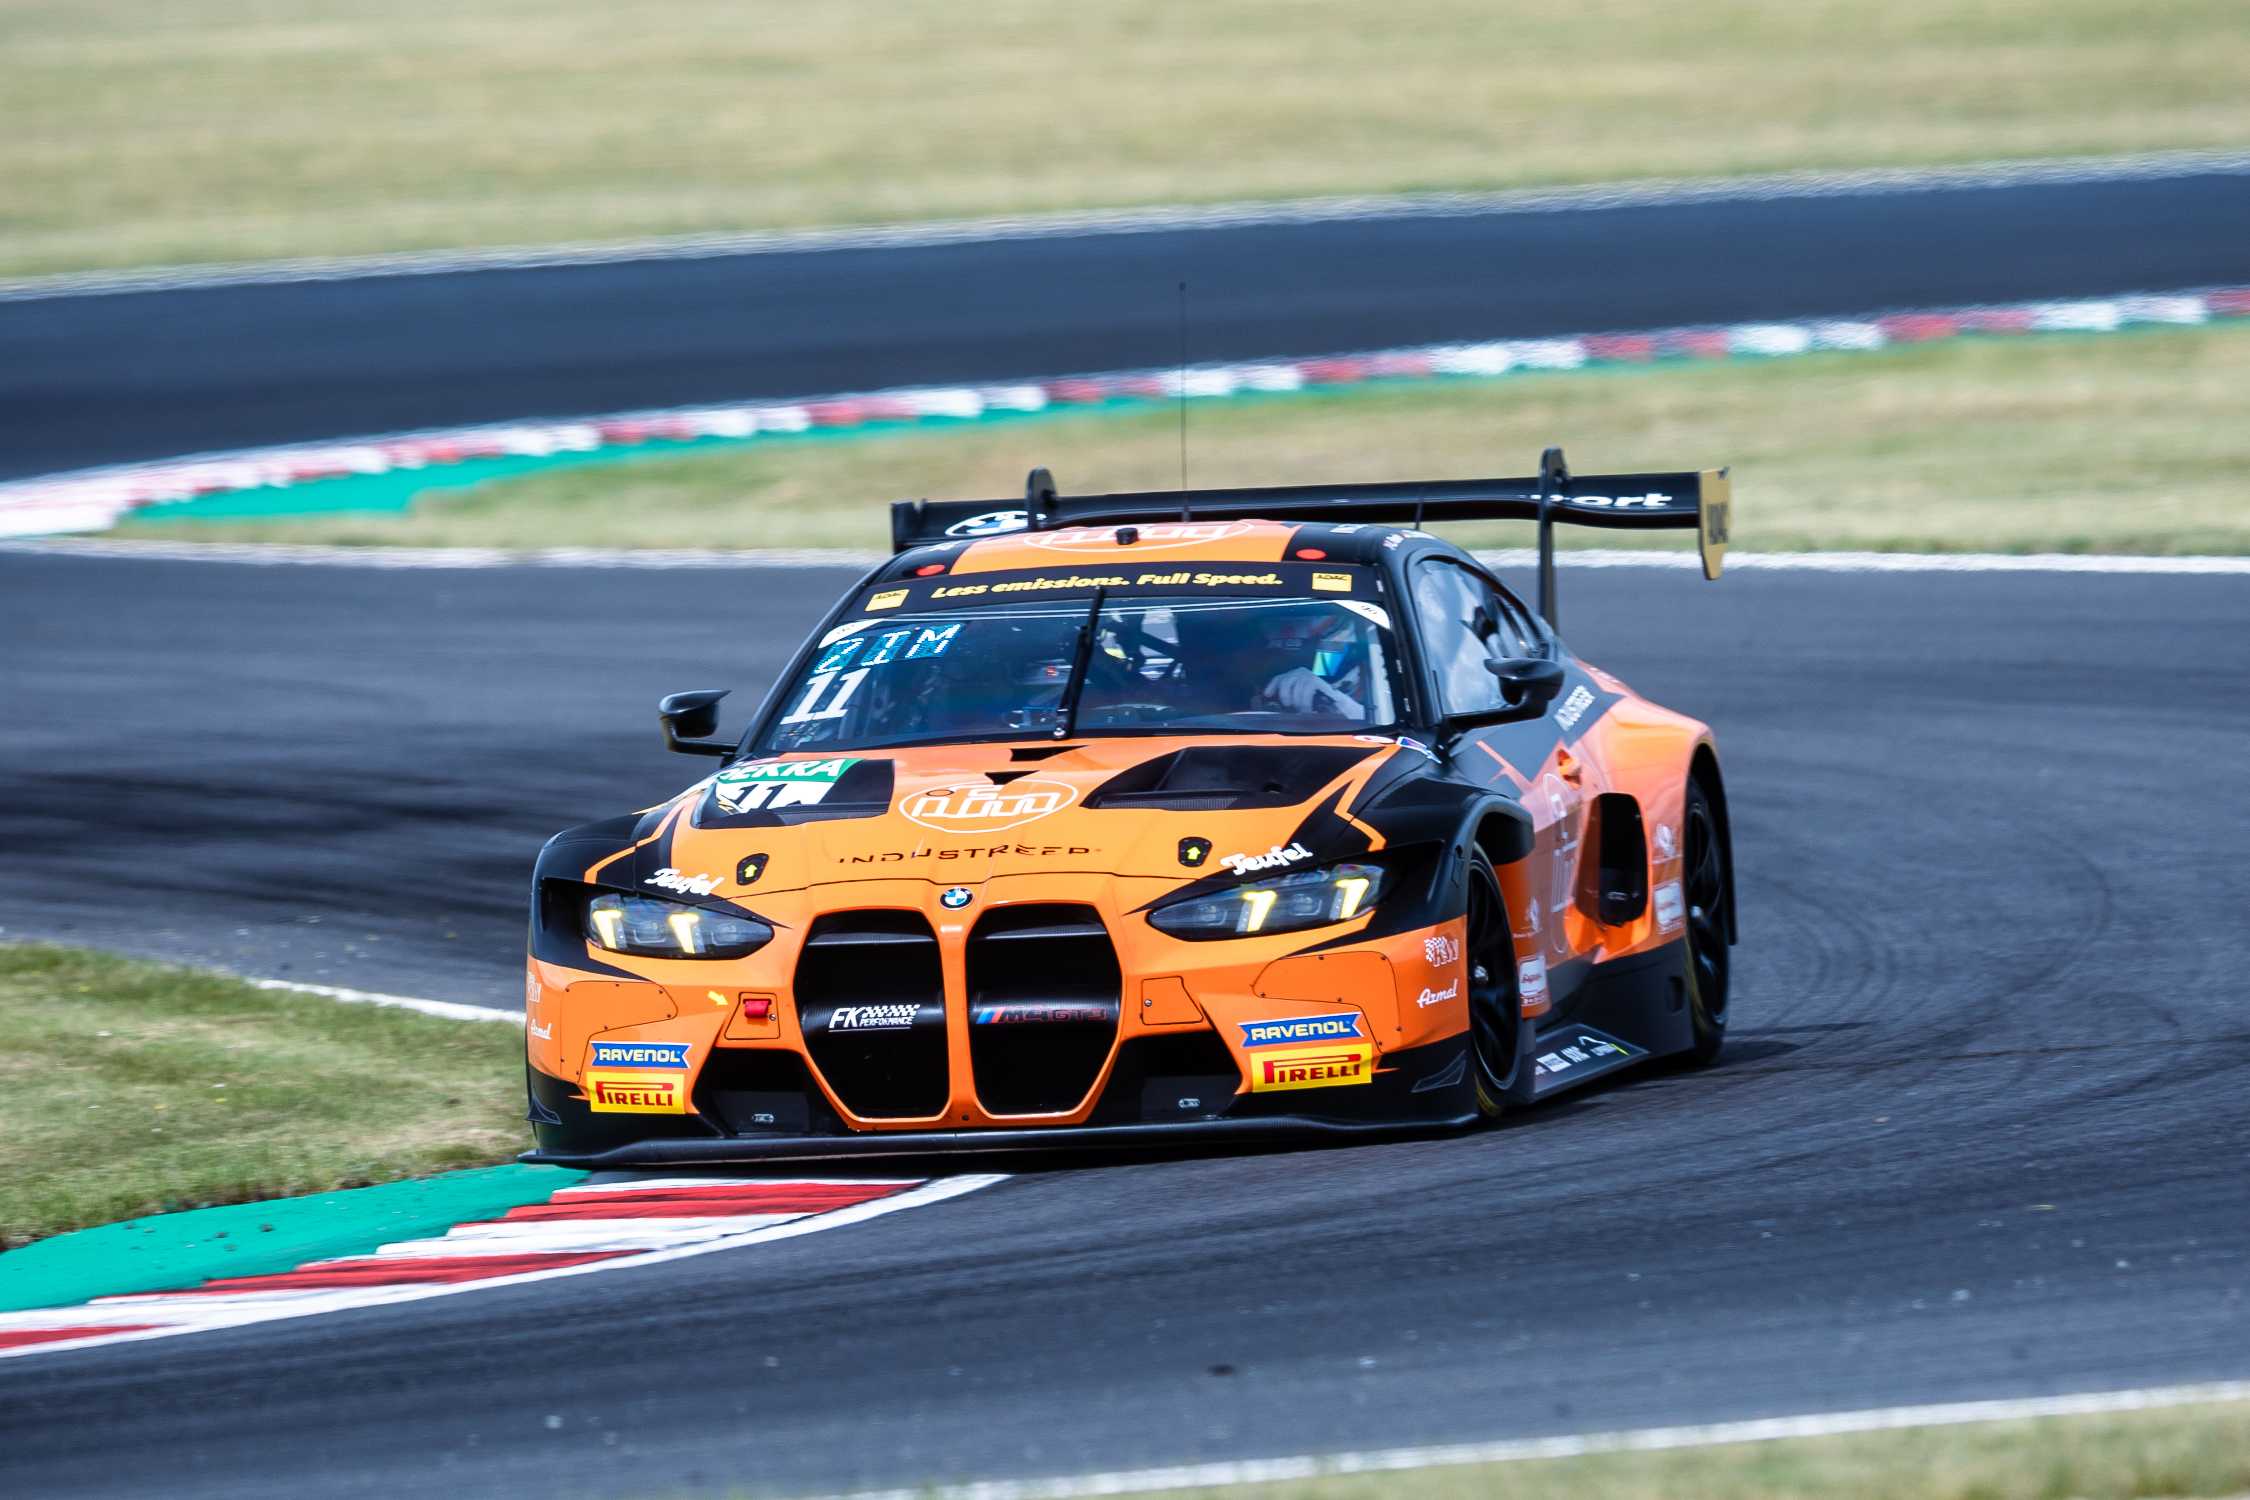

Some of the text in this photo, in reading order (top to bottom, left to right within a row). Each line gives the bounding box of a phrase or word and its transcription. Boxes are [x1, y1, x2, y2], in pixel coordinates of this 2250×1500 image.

[930, 572, 1284, 599] Less emissions. Full Speed.
[780, 667, 872, 725] 11
[1220, 842, 1315, 876] Teufel
[828, 1007, 866, 1029] FK
[1250, 1020, 1351, 1041] RAVENOL
[599, 1048, 681, 1063] RAVENOL
[1262, 1053, 1362, 1084] PIRELLI
[595, 1080, 674, 1107] PIRELLI
